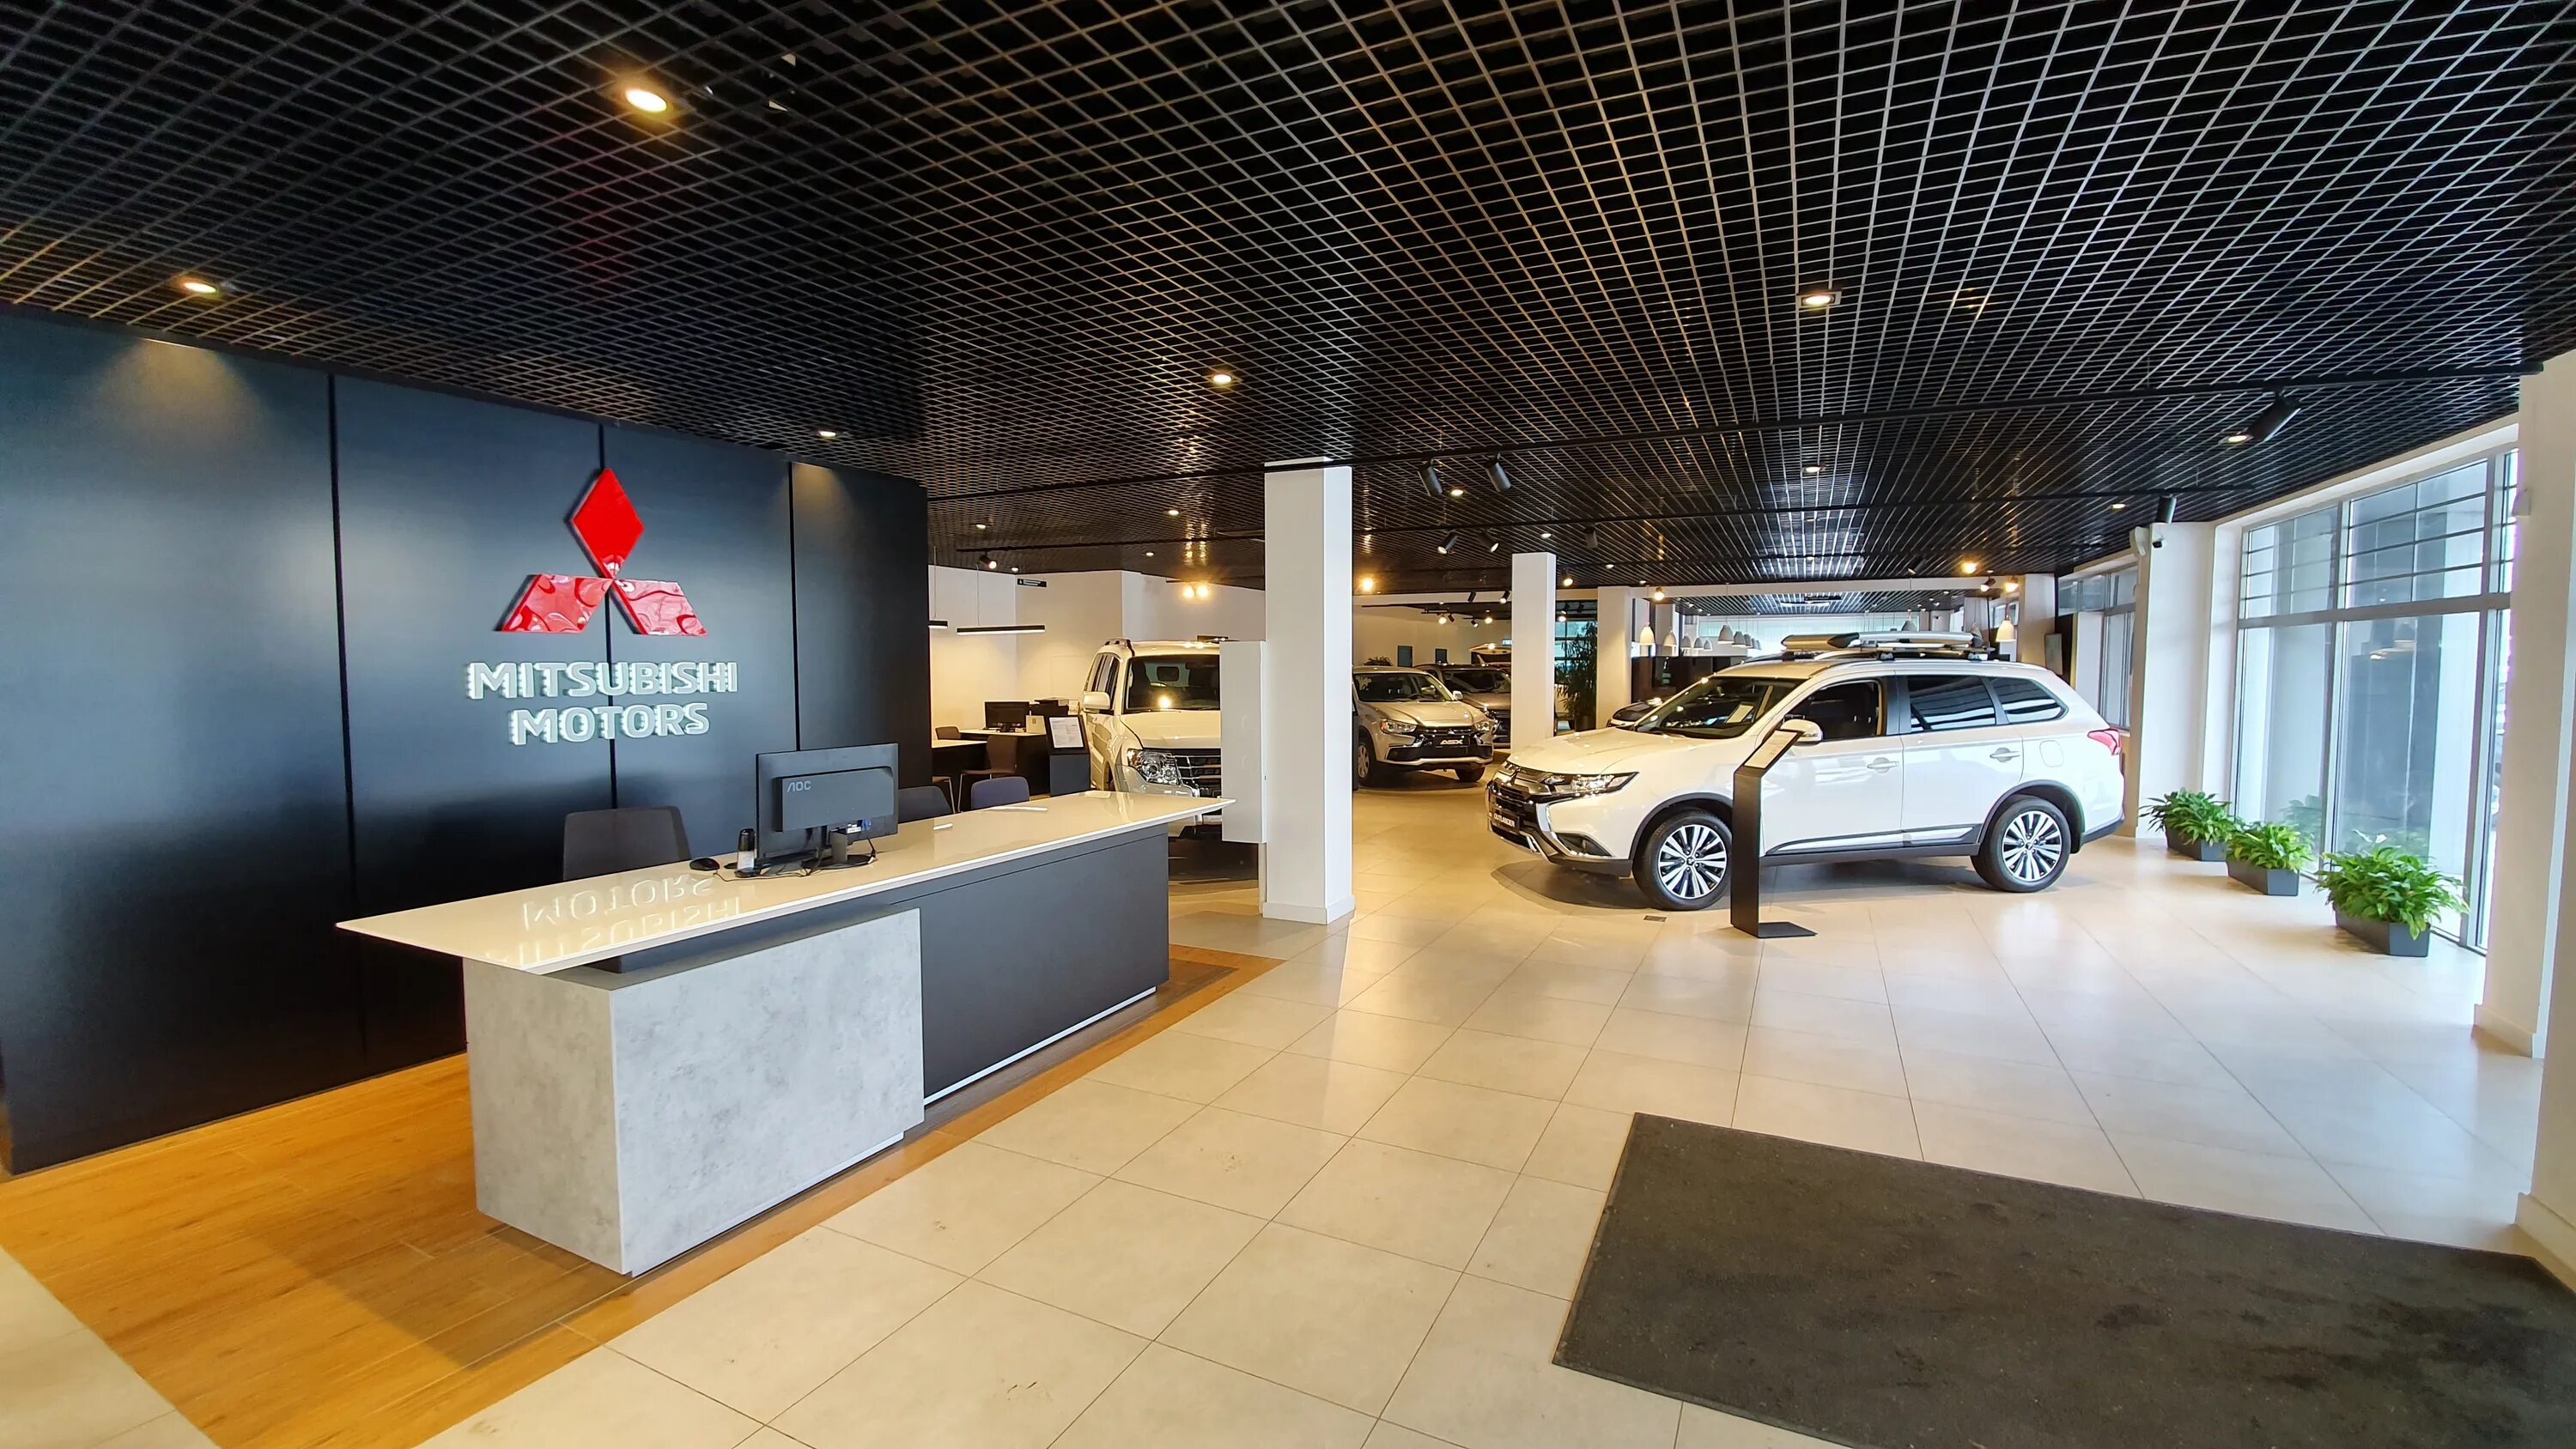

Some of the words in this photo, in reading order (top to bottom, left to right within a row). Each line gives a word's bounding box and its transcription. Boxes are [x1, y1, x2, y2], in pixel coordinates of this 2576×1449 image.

[468, 662, 738, 700] MITSUBISHI
[509, 702, 711, 745] MOTORS
[787, 780, 811, 792] AOC
